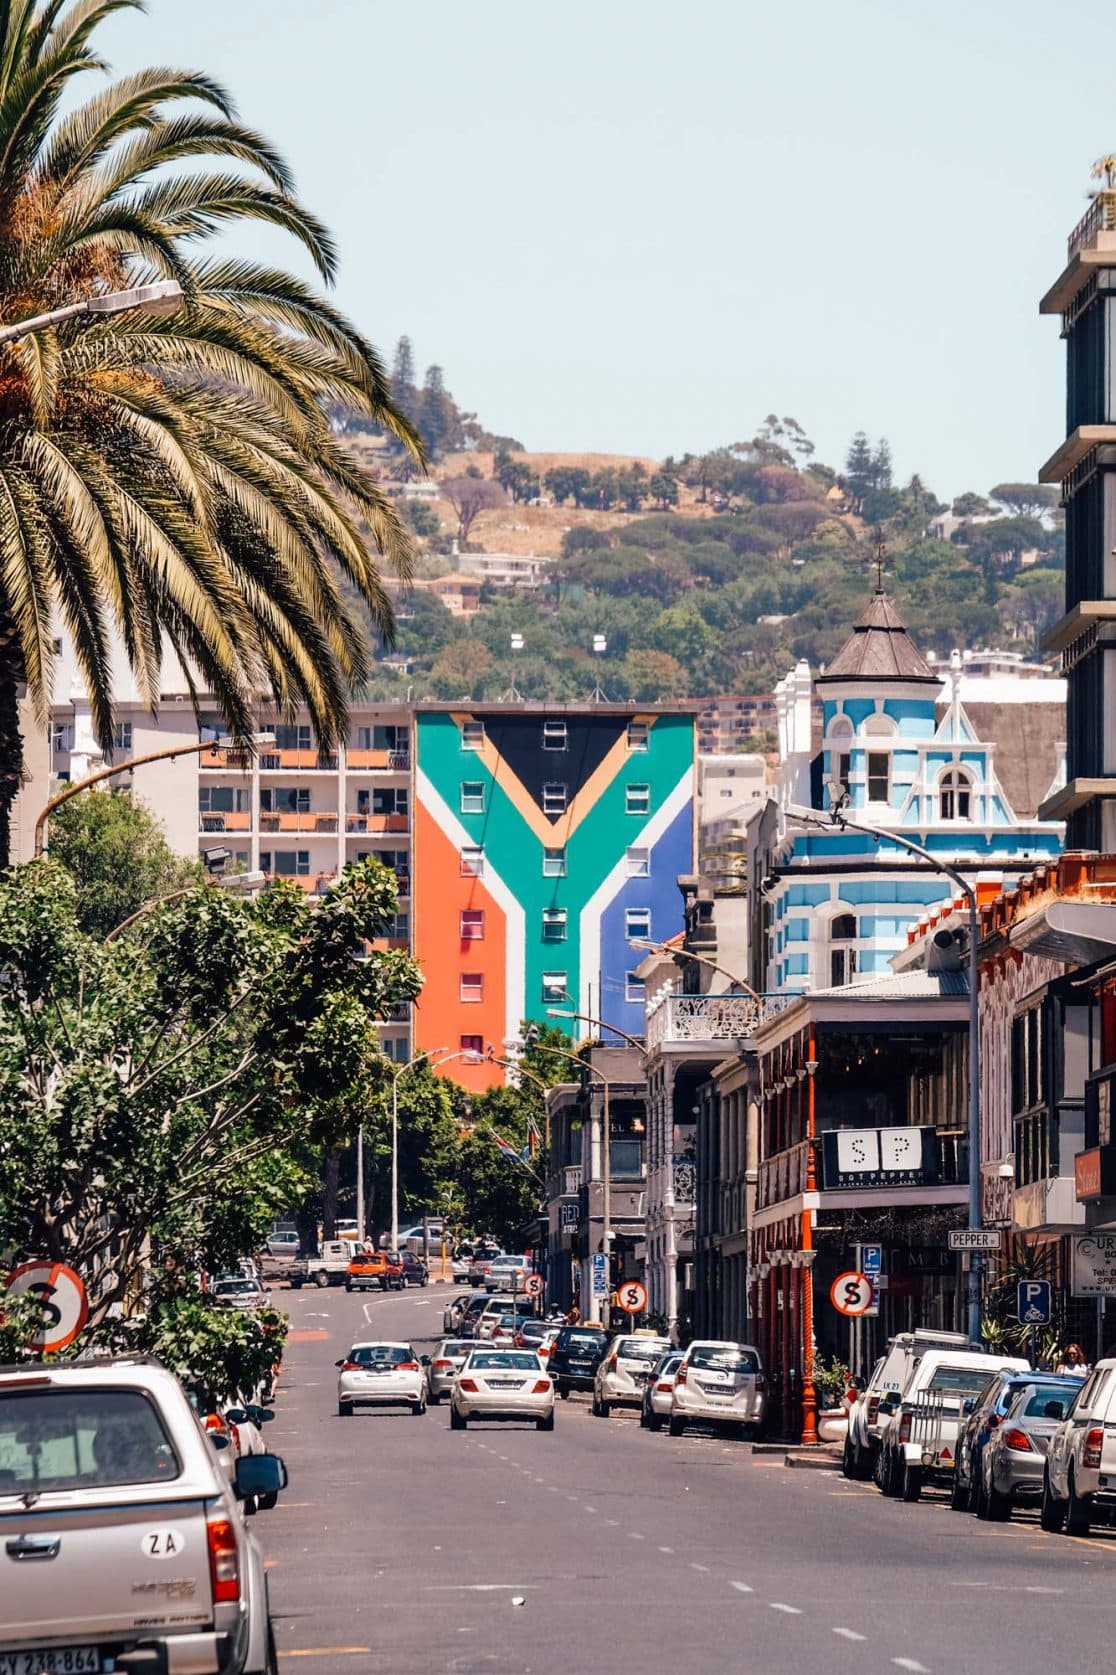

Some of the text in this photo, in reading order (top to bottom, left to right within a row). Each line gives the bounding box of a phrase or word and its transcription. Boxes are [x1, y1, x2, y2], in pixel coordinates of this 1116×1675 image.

[852, 1137, 910, 1163] S P
[838, 1173, 865, 1182] SGT
[953, 1234, 988, 1245] PEPPER
[867, 1248, 878, 1260] P
[627, 1289, 638, 1305] S
[844, 1282, 861, 1305] S
[1026, 1283, 1042, 1302] P
